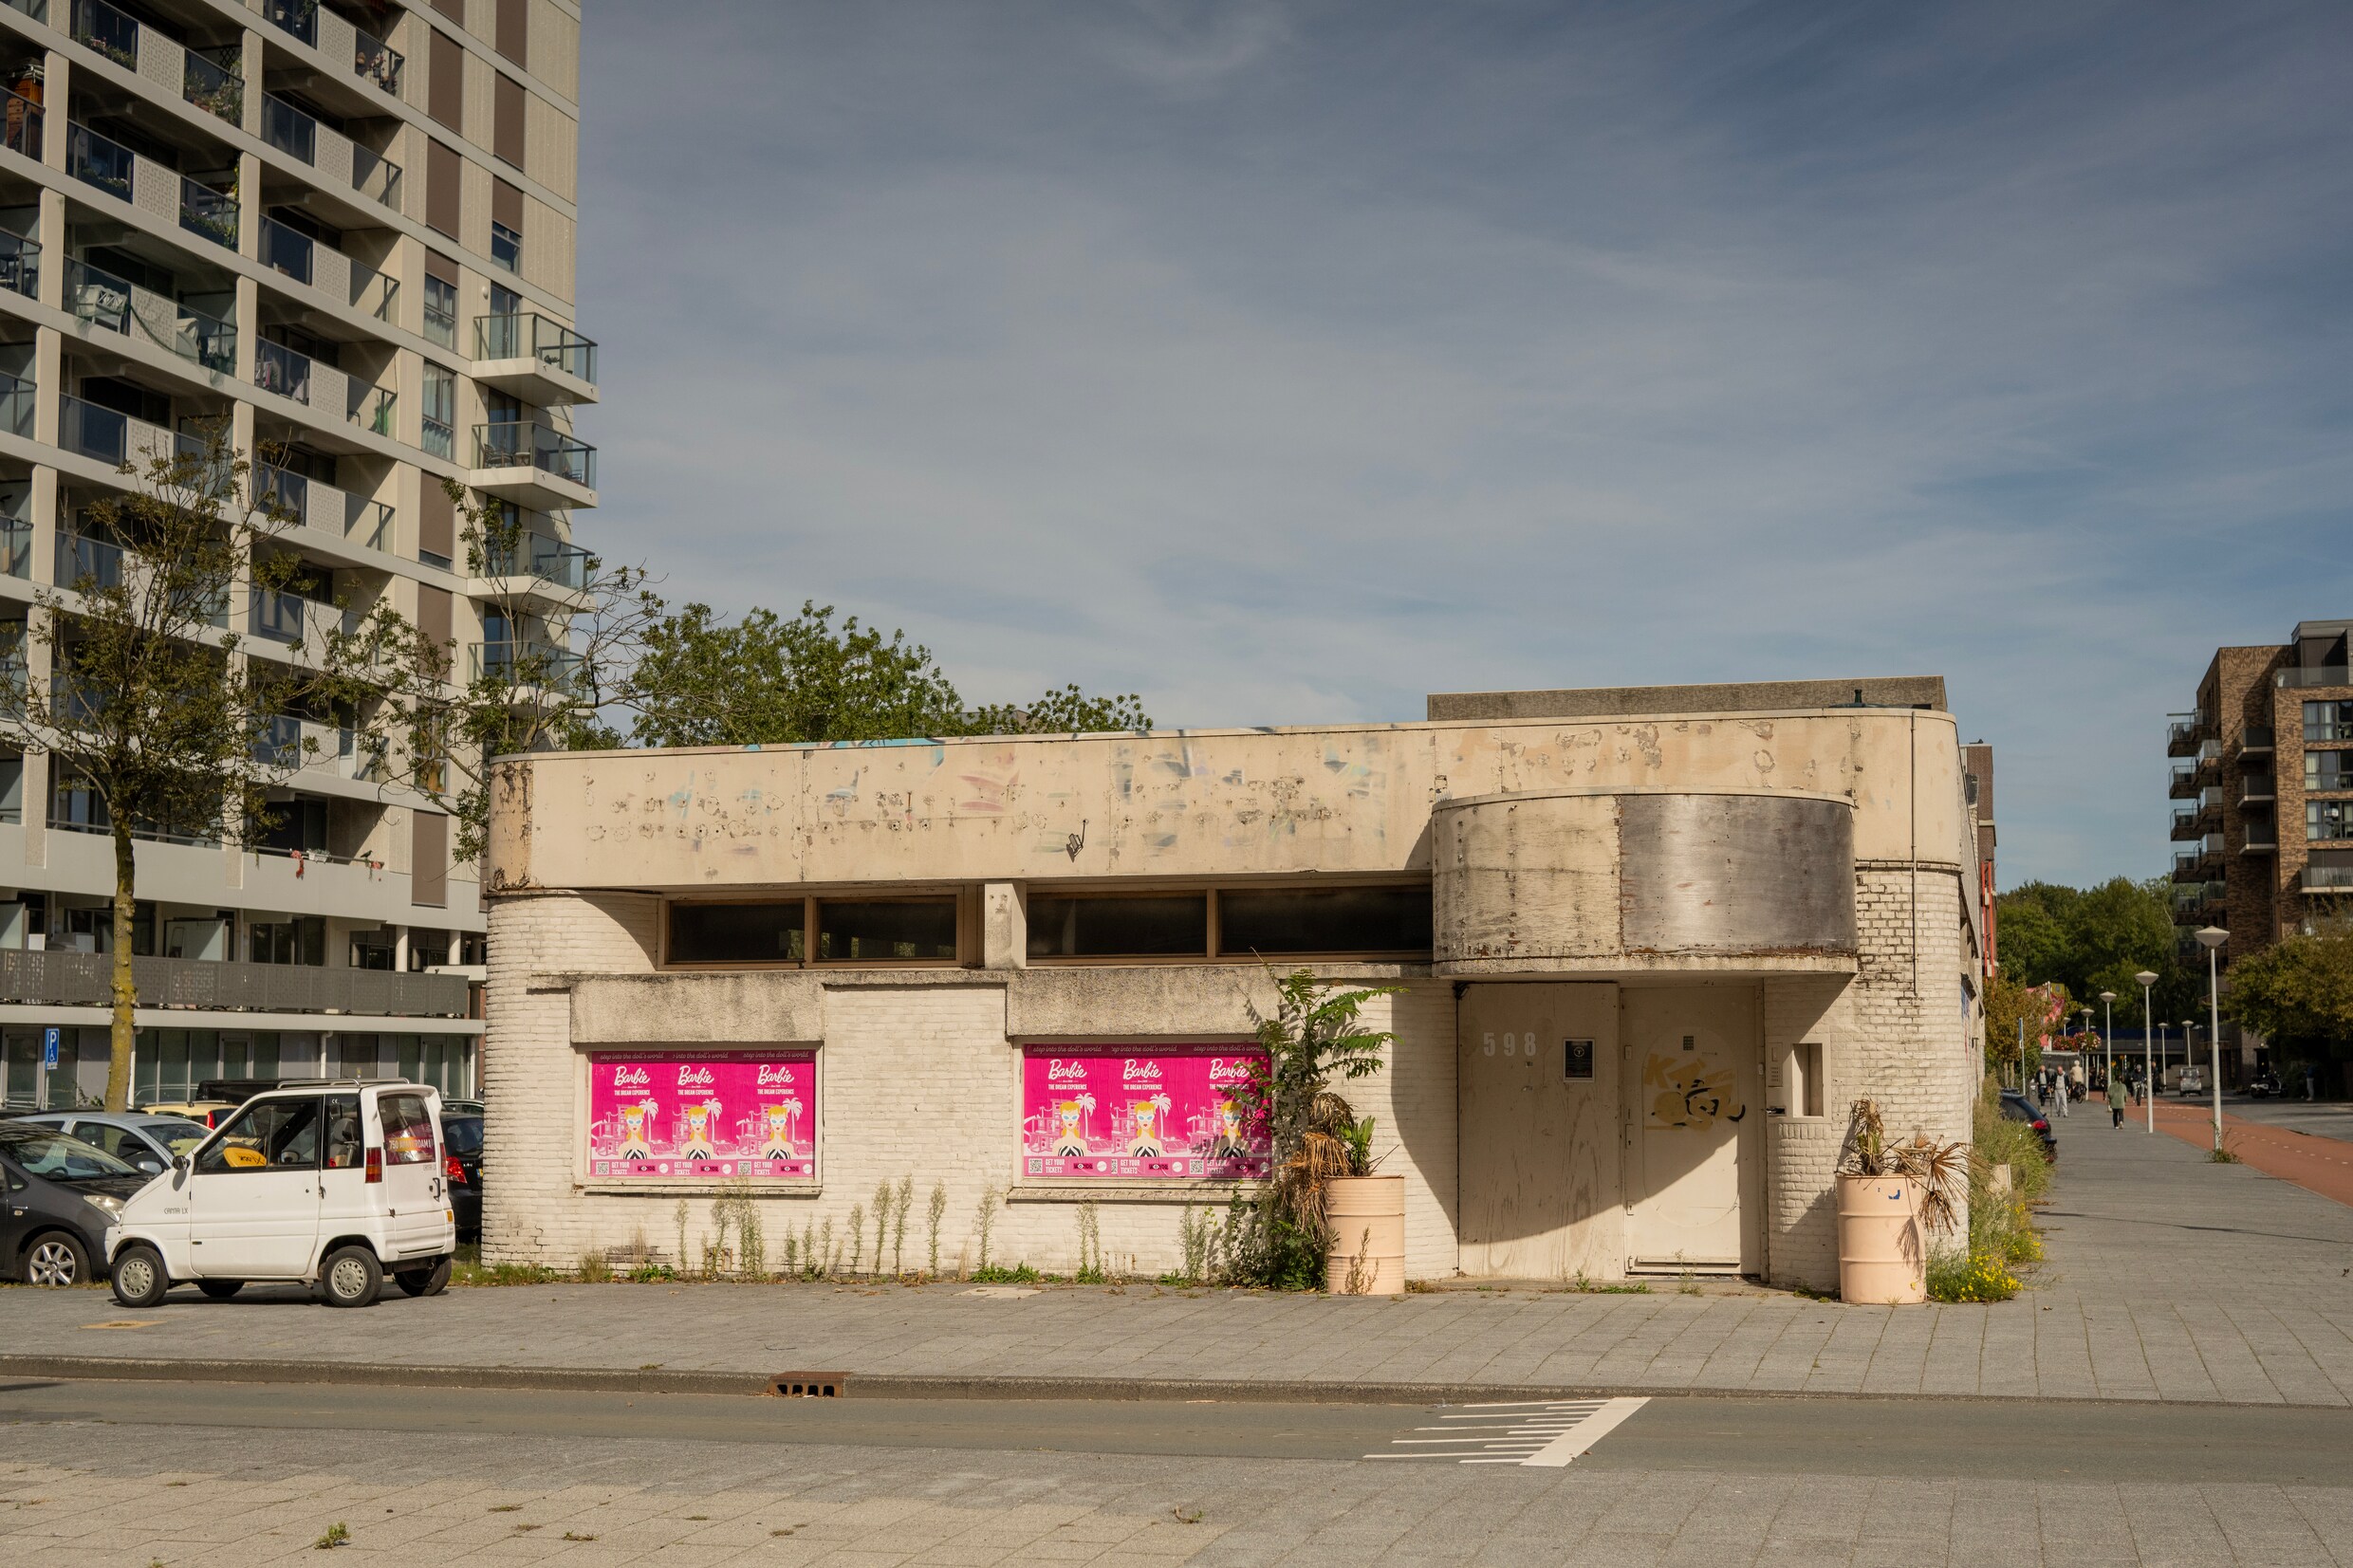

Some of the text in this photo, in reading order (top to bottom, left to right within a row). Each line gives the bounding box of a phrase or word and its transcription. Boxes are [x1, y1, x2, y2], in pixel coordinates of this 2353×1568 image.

[49, 1032, 57, 1049] P
[1483, 1032, 1536, 1057] 598
[614, 1065, 650, 1086] Barbie
[677, 1065, 714, 1085] Barbie
[757, 1064, 794, 1085] Barbie
[1047, 1059, 1087, 1080] Barbie
[1123, 1059, 1162, 1080] Barbie
